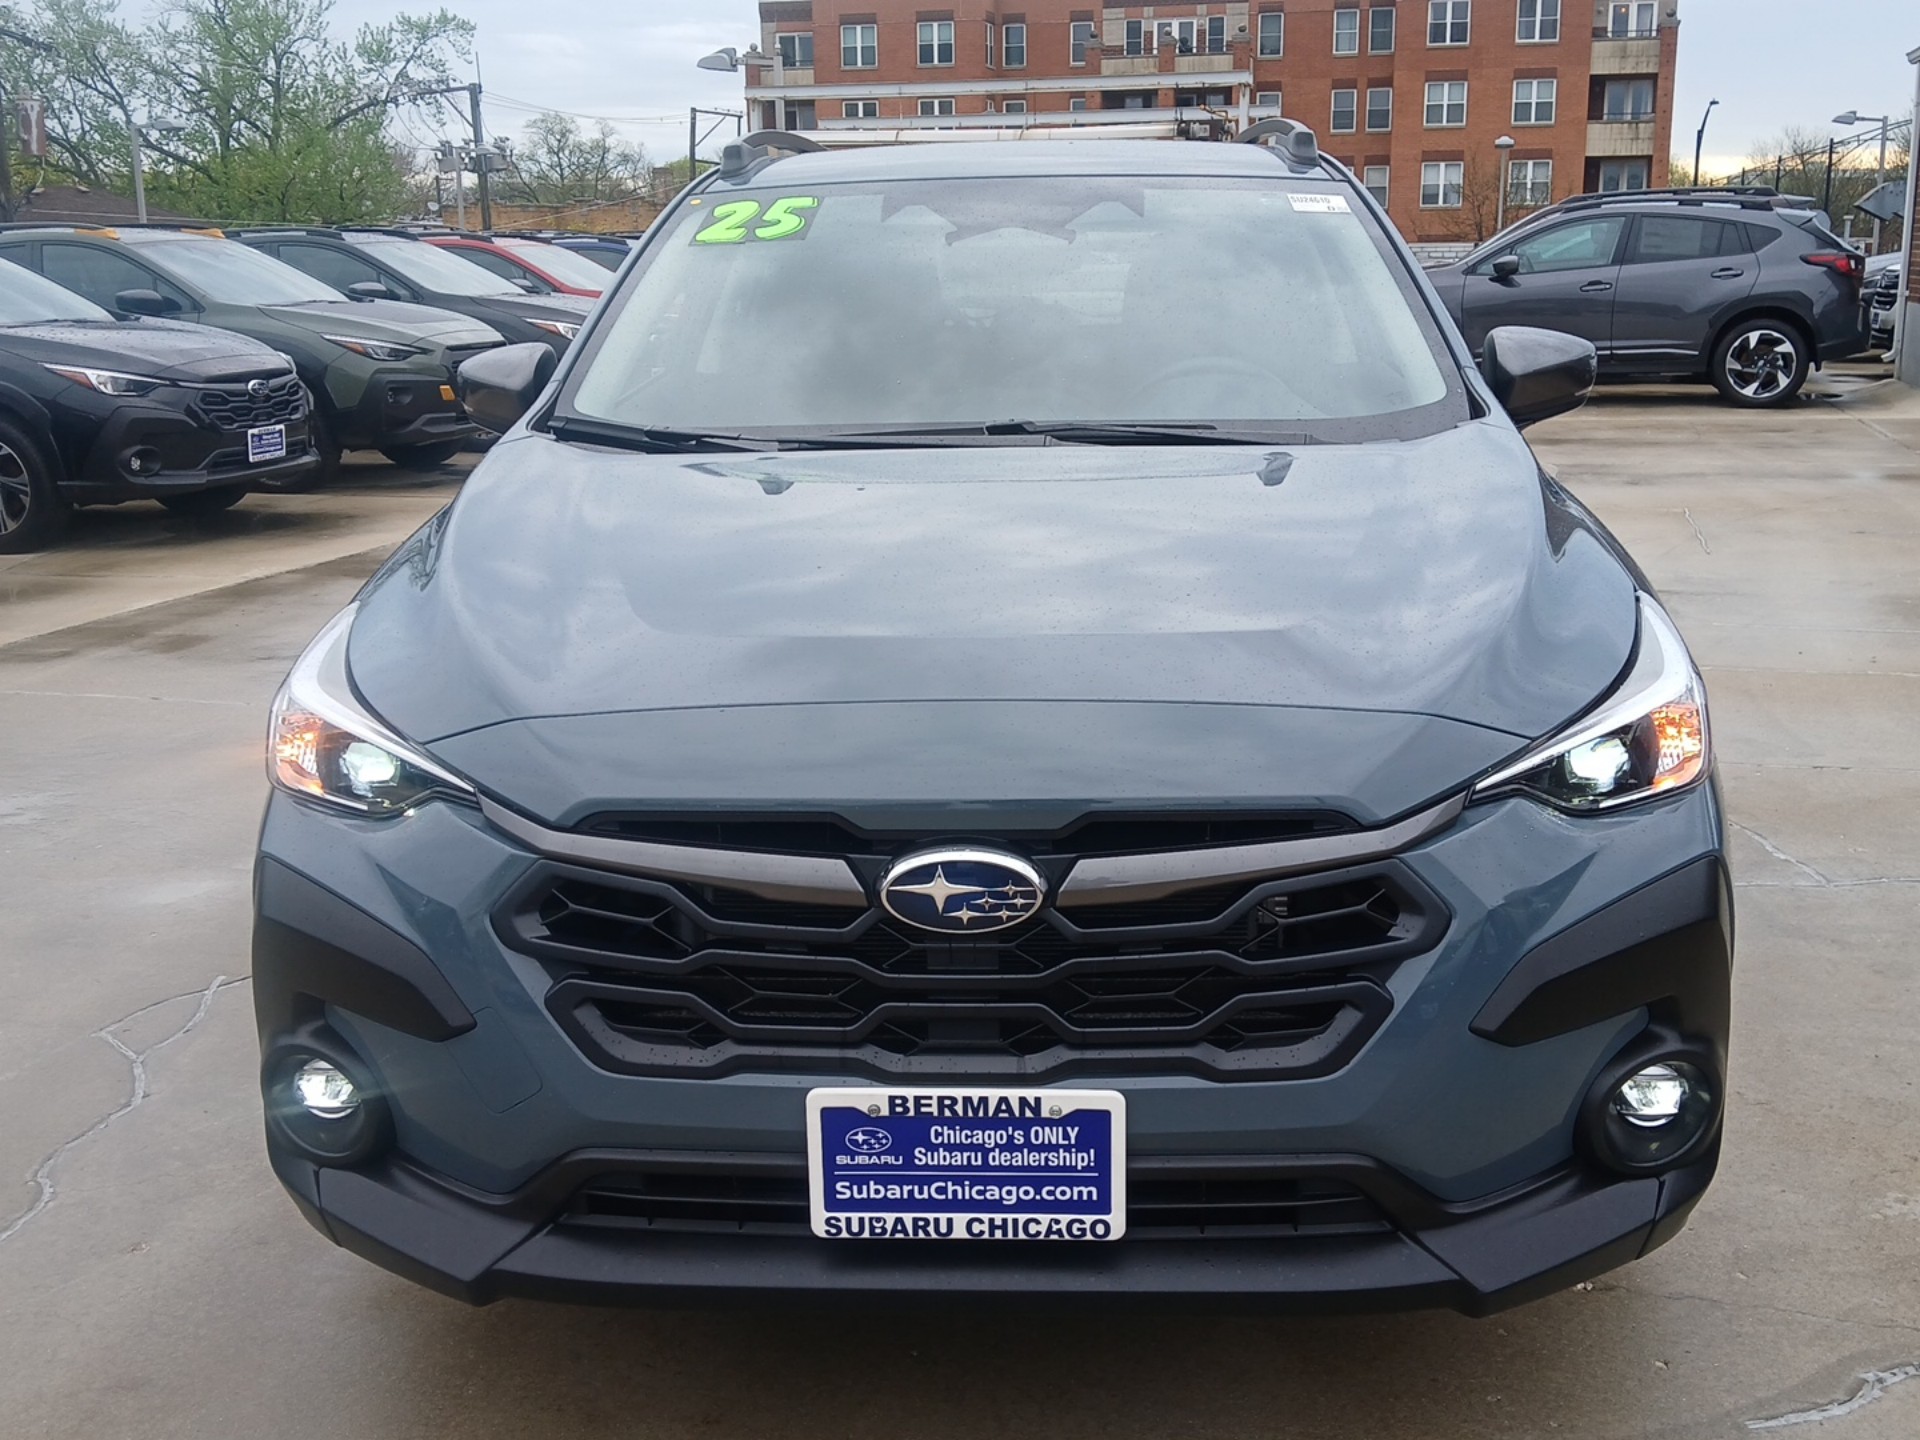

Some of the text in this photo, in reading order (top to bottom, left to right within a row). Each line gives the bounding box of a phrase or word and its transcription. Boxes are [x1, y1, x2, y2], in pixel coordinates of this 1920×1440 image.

[695, 196, 818, 244] 25
[888, 1095, 1042, 1118] BERMAN
[930, 1125, 1079, 1148] Chicago's ONLY
[835, 1155, 903, 1165] SUBARU
[914, 1147, 1095, 1170] Subaru dealership!
[835, 1180, 1098, 1205] SubaruChicago.com
[824, 1216, 1112, 1239] SUBARU CHICAGO
